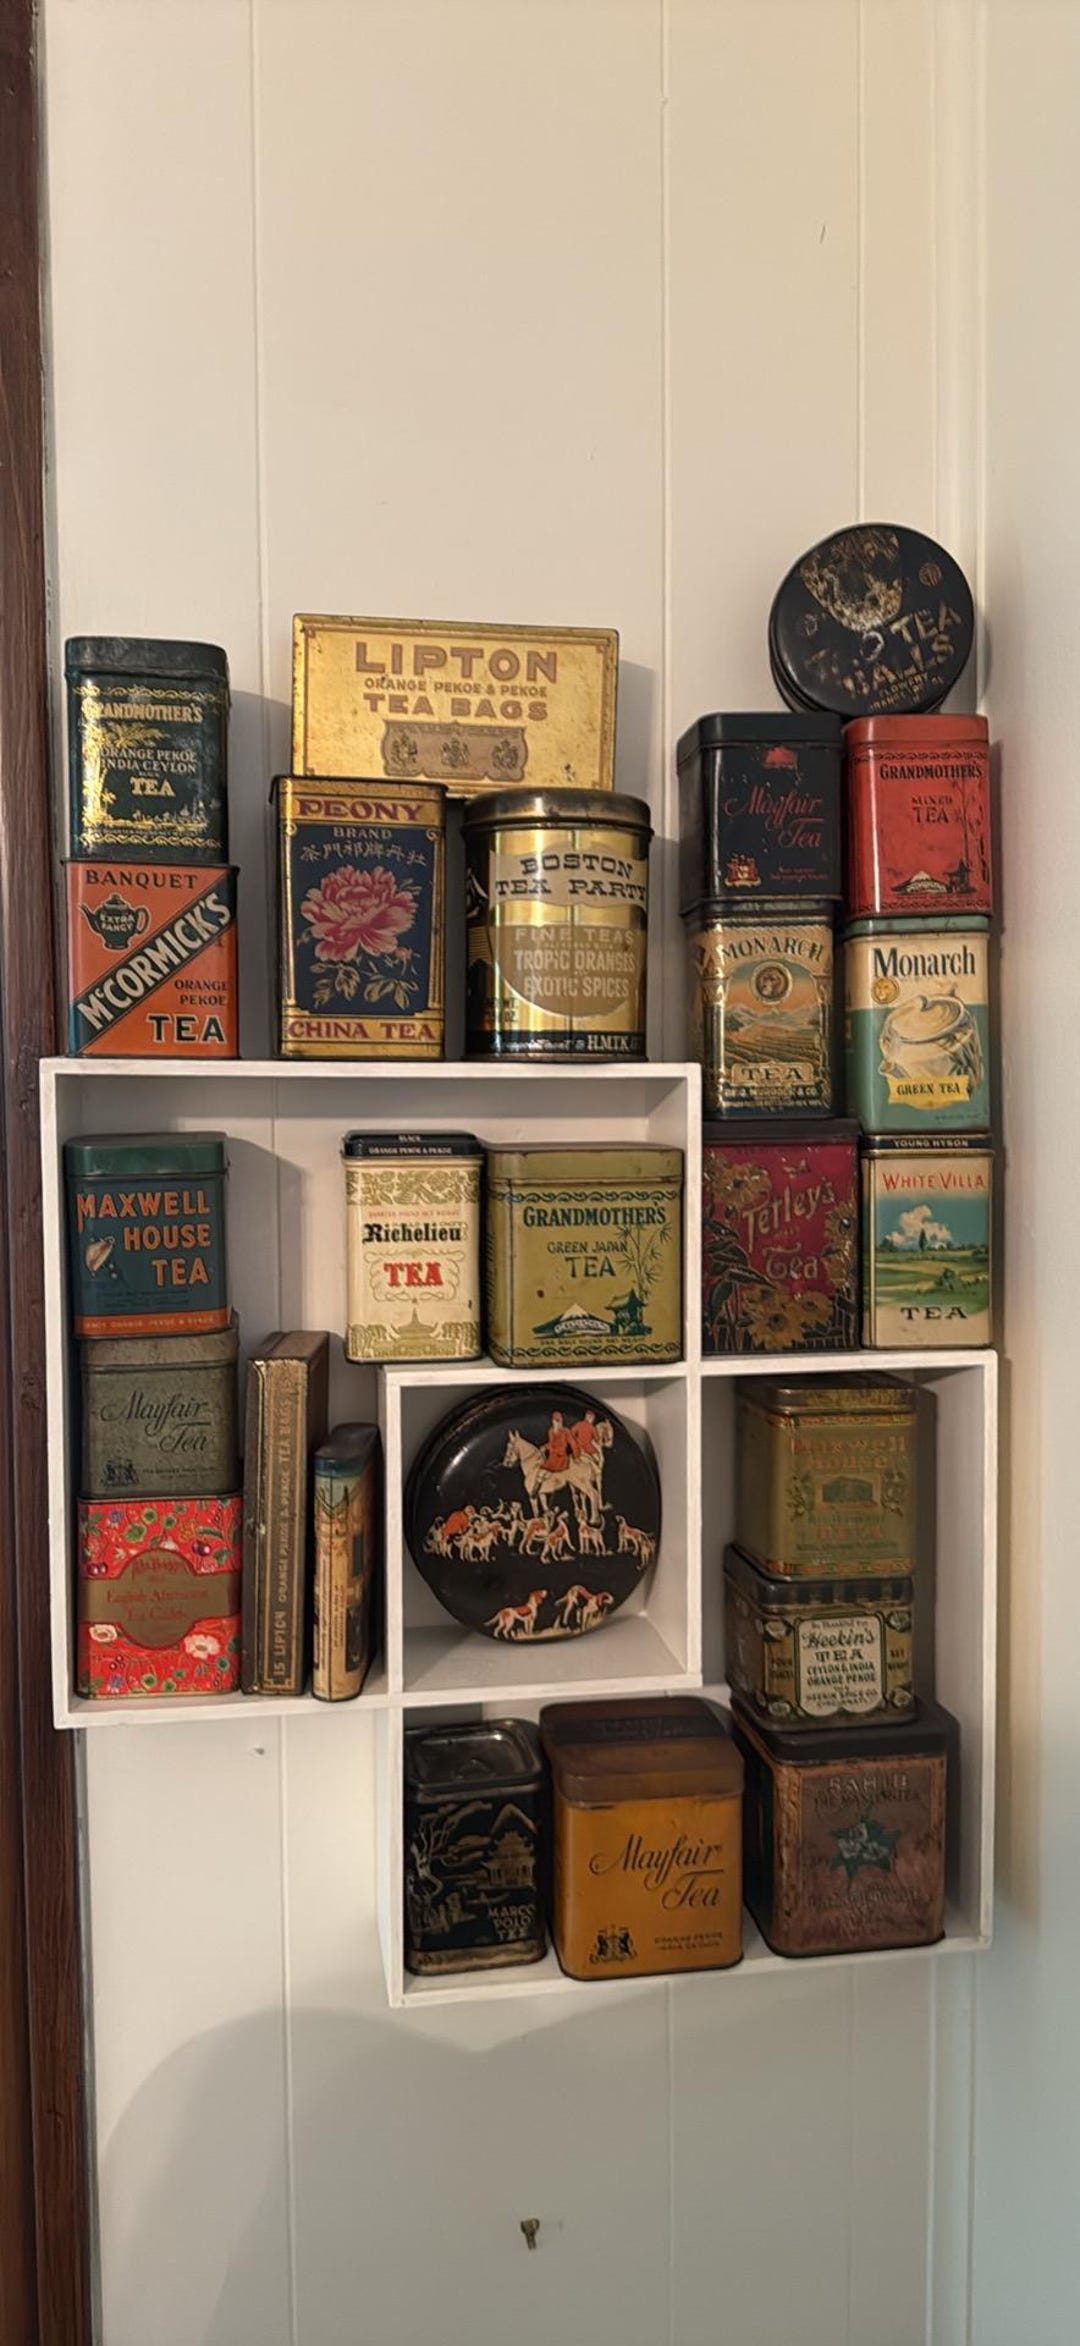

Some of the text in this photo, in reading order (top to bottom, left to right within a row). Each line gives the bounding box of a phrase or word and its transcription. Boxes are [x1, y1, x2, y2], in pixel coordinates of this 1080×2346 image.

[891, 600, 962, 642] TEA
[356, 642, 557, 684] LIPTON
[365, 677, 547, 697] ORANGE PEKOE & PEKOE
[363, 693, 548, 721] TEA BAGS
[142, 760, 196, 773] CEYLON
[157, 750, 197, 762] PEKOE
[880, 762, 982, 780] GRANDMOTHER'S
[130, 777, 175, 796] TEA
[300, 800, 424, 821] PEONY
[724, 786, 823, 831] Mayfair
[913, 807, 949, 823] TEA
[333, 826, 392, 840] BRAND
[778, 817, 824, 848] Tea
[521, 854, 633, 879] BOSTON
[86, 870, 197, 889] BANQUET
[495, 879, 646, 900] TEA PARTY
[100, 914, 135, 922] EXTRA
[102, 923, 132, 931] FANCY
[516, 928, 634, 944] FINE TEAS
[722, 936, 824, 962] MONARCH
[77, 893, 231, 1029] McCORMICK'S
[514, 950, 635, 972] TROPIC ORANGES
[873, 946, 975, 978] Monarch
[174, 980, 229, 991] ORANGE
[583, 976, 630, 997] SPICES
[180, 995, 227, 1006] PEKOE
[148, 1013, 227, 1043] TEA
[288, 1021, 436, 1040] CHINA TEA
[741, 1067, 804, 1080] TEA
[897, 1081, 960, 1095] GREEN TEA
[894, 1139, 969, 1148] YOUNG HYSON
[882, 1172, 986, 1190] WHITE VILLA
[77, 1190, 211, 1233] MAXWELL
[523, 1202, 666, 1227] GRANDMOTHER'S
[123, 1223, 212, 1251] HOUSE
[362, 1222, 461, 1244] Richelieu
[547, 1241, 628, 1254] GREEN JAPAN
[151, 1257, 209, 1287] TEA
[565, 1256, 616, 1278] TEA
[763, 1242, 819, 1281] Tea
[383, 1262, 444, 1288] TEA
[900, 1306, 968, 1320] TEA
[100, 1390, 209, 1437] Mayfair
[159, 1421, 211, 1452] Tea
[279, 1439, 292, 1464] TEA
[273, 1611, 286, 1656] LIPTON
[815, 1648, 863, 1662] TEA
[588, 1833, 723, 1891] Mayfair
[661, 1868, 724, 1910] Tea
